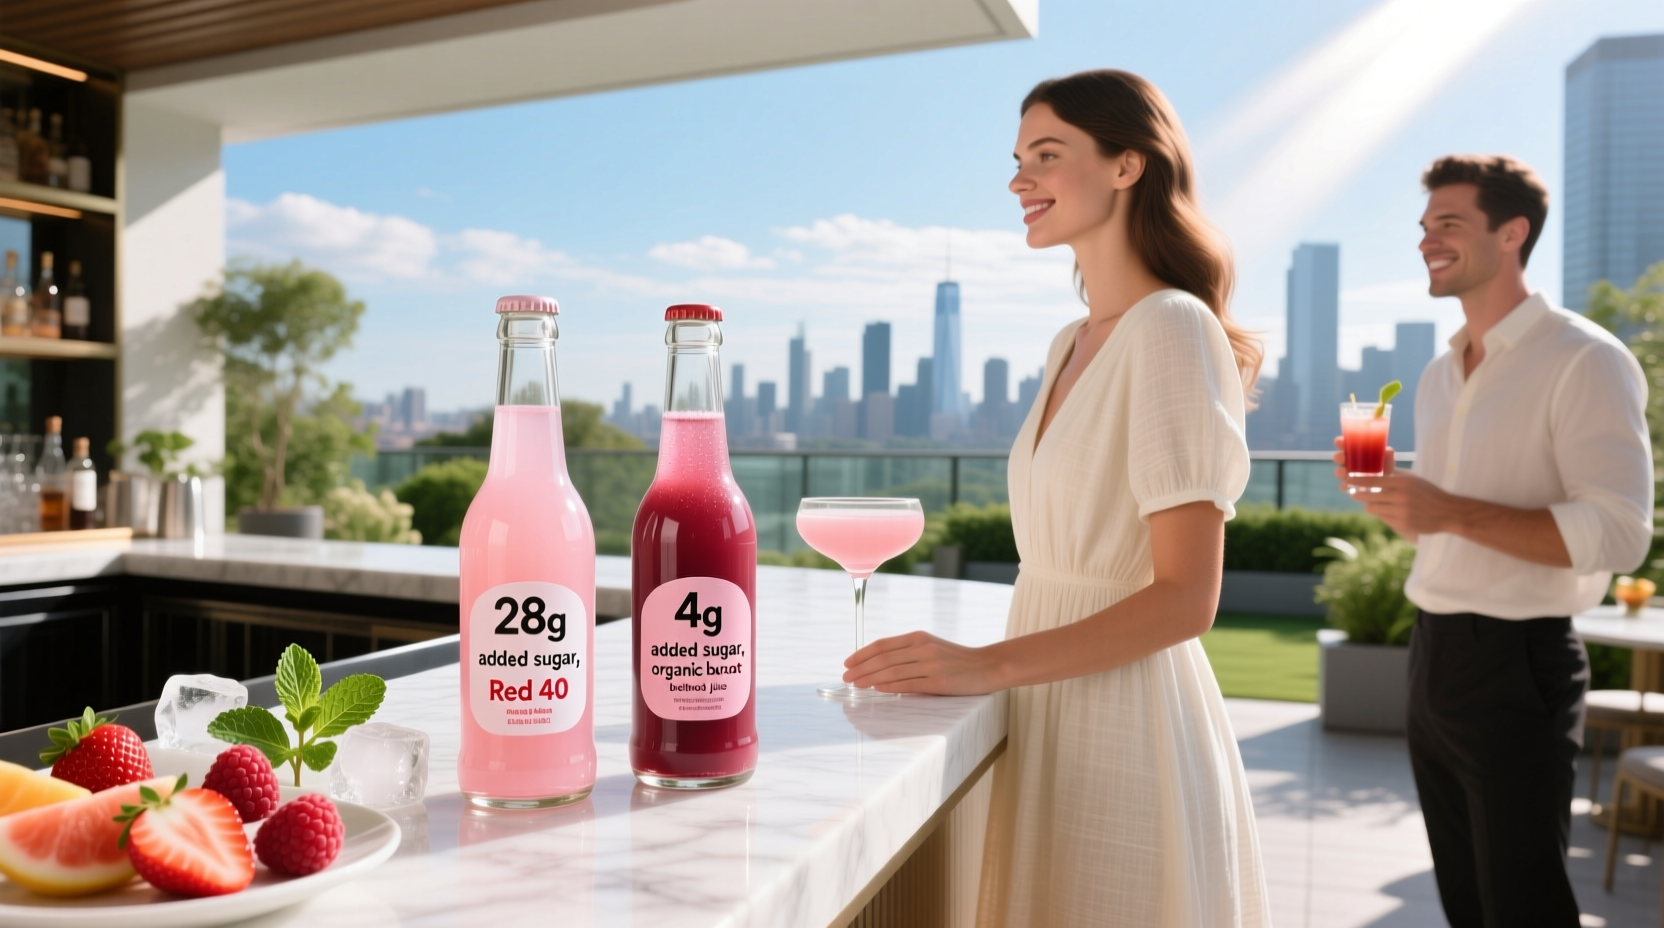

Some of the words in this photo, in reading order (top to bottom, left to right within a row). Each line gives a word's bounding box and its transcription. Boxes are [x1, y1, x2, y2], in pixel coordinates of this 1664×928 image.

[494, 597, 566, 643] 28g
[674, 592, 722, 637] 4g
[478, 650, 528, 667] added
[533, 652, 580, 671] sugar,
[651, 642, 698, 657] added
[703, 644, 745, 660] sugar,
[651, 662, 703, 680] organic
[489, 678, 533, 702] Red
[538, 677, 569, 701] 40
